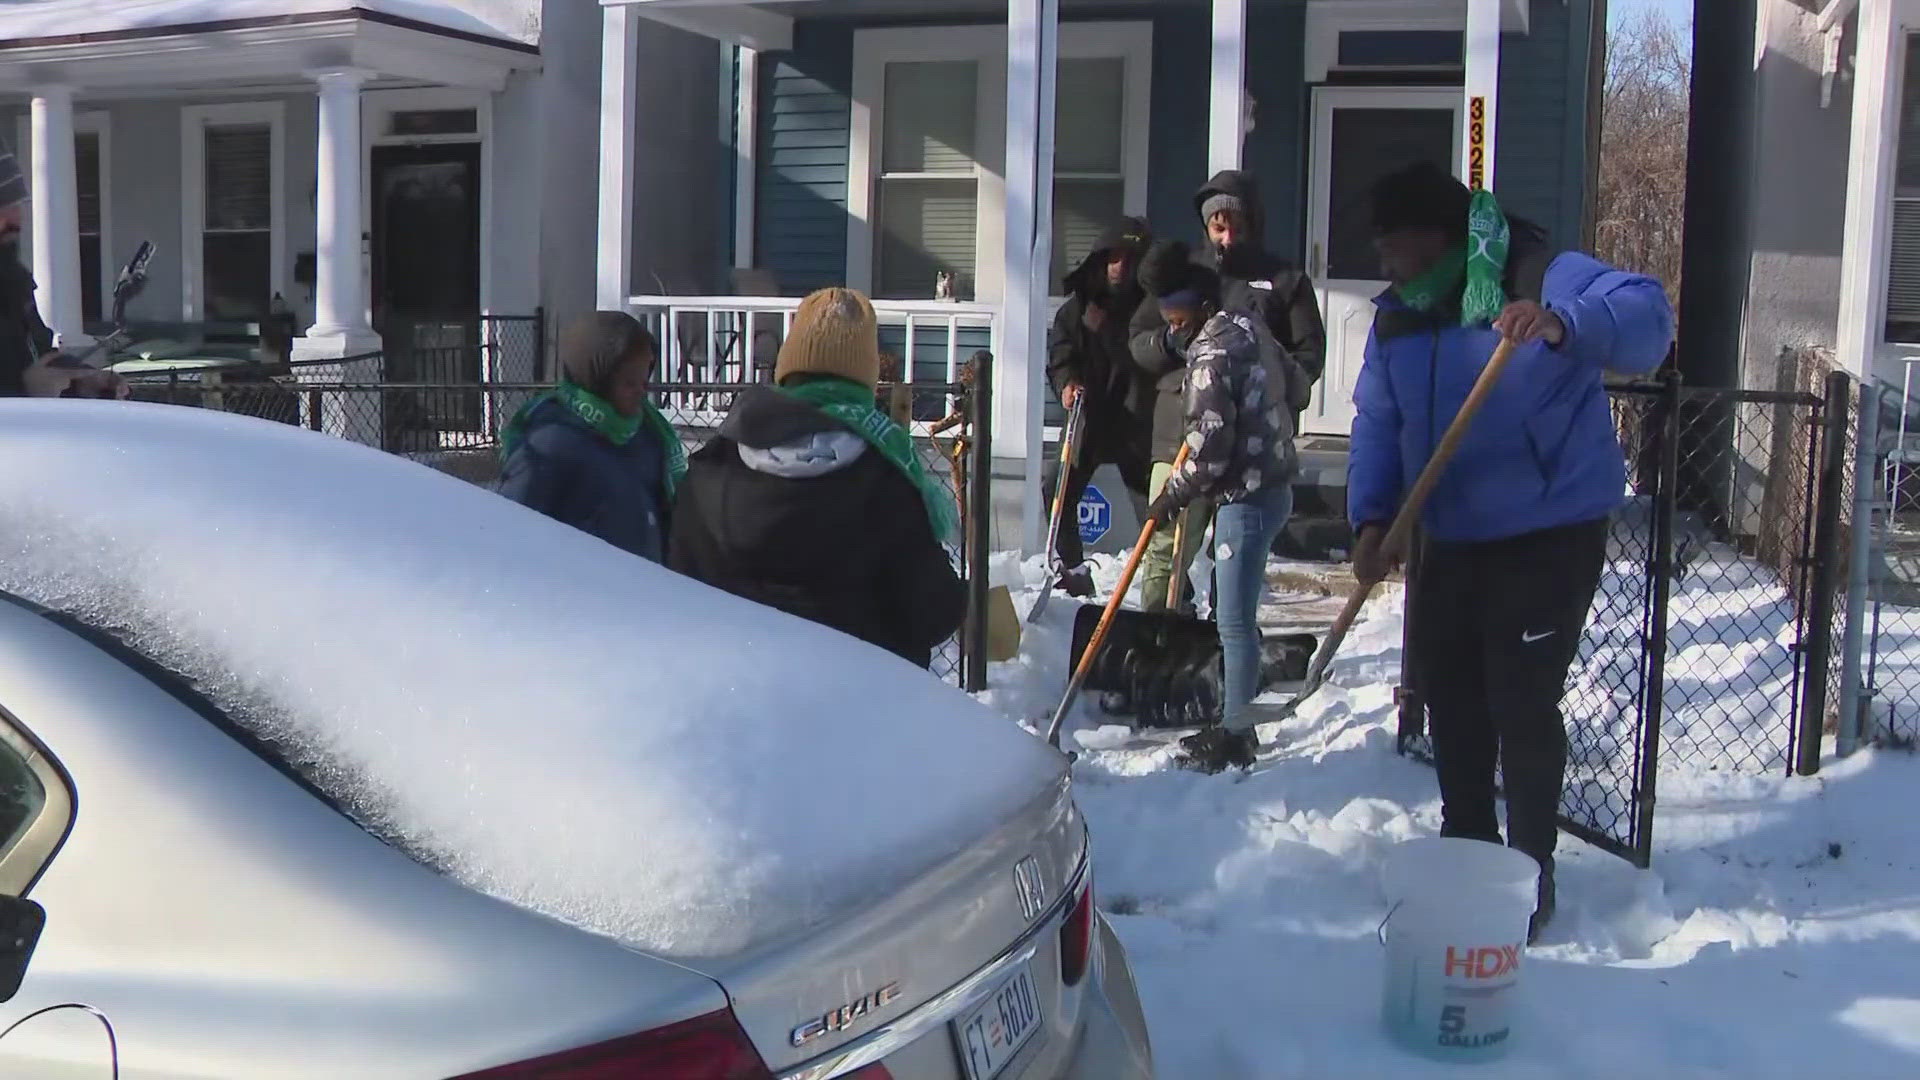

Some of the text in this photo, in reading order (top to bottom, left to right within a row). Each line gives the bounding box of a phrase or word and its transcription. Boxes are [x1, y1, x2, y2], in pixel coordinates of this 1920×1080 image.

[1470, 97, 1484, 190] 3325
[1077, 501, 1105, 525] DT
[1445, 944, 1520, 978] HDX
[791, 980, 902, 1047] CIVIC
[965, 973, 1033, 1080] FT 5610
[1439, 1005, 1466, 1033] 5
